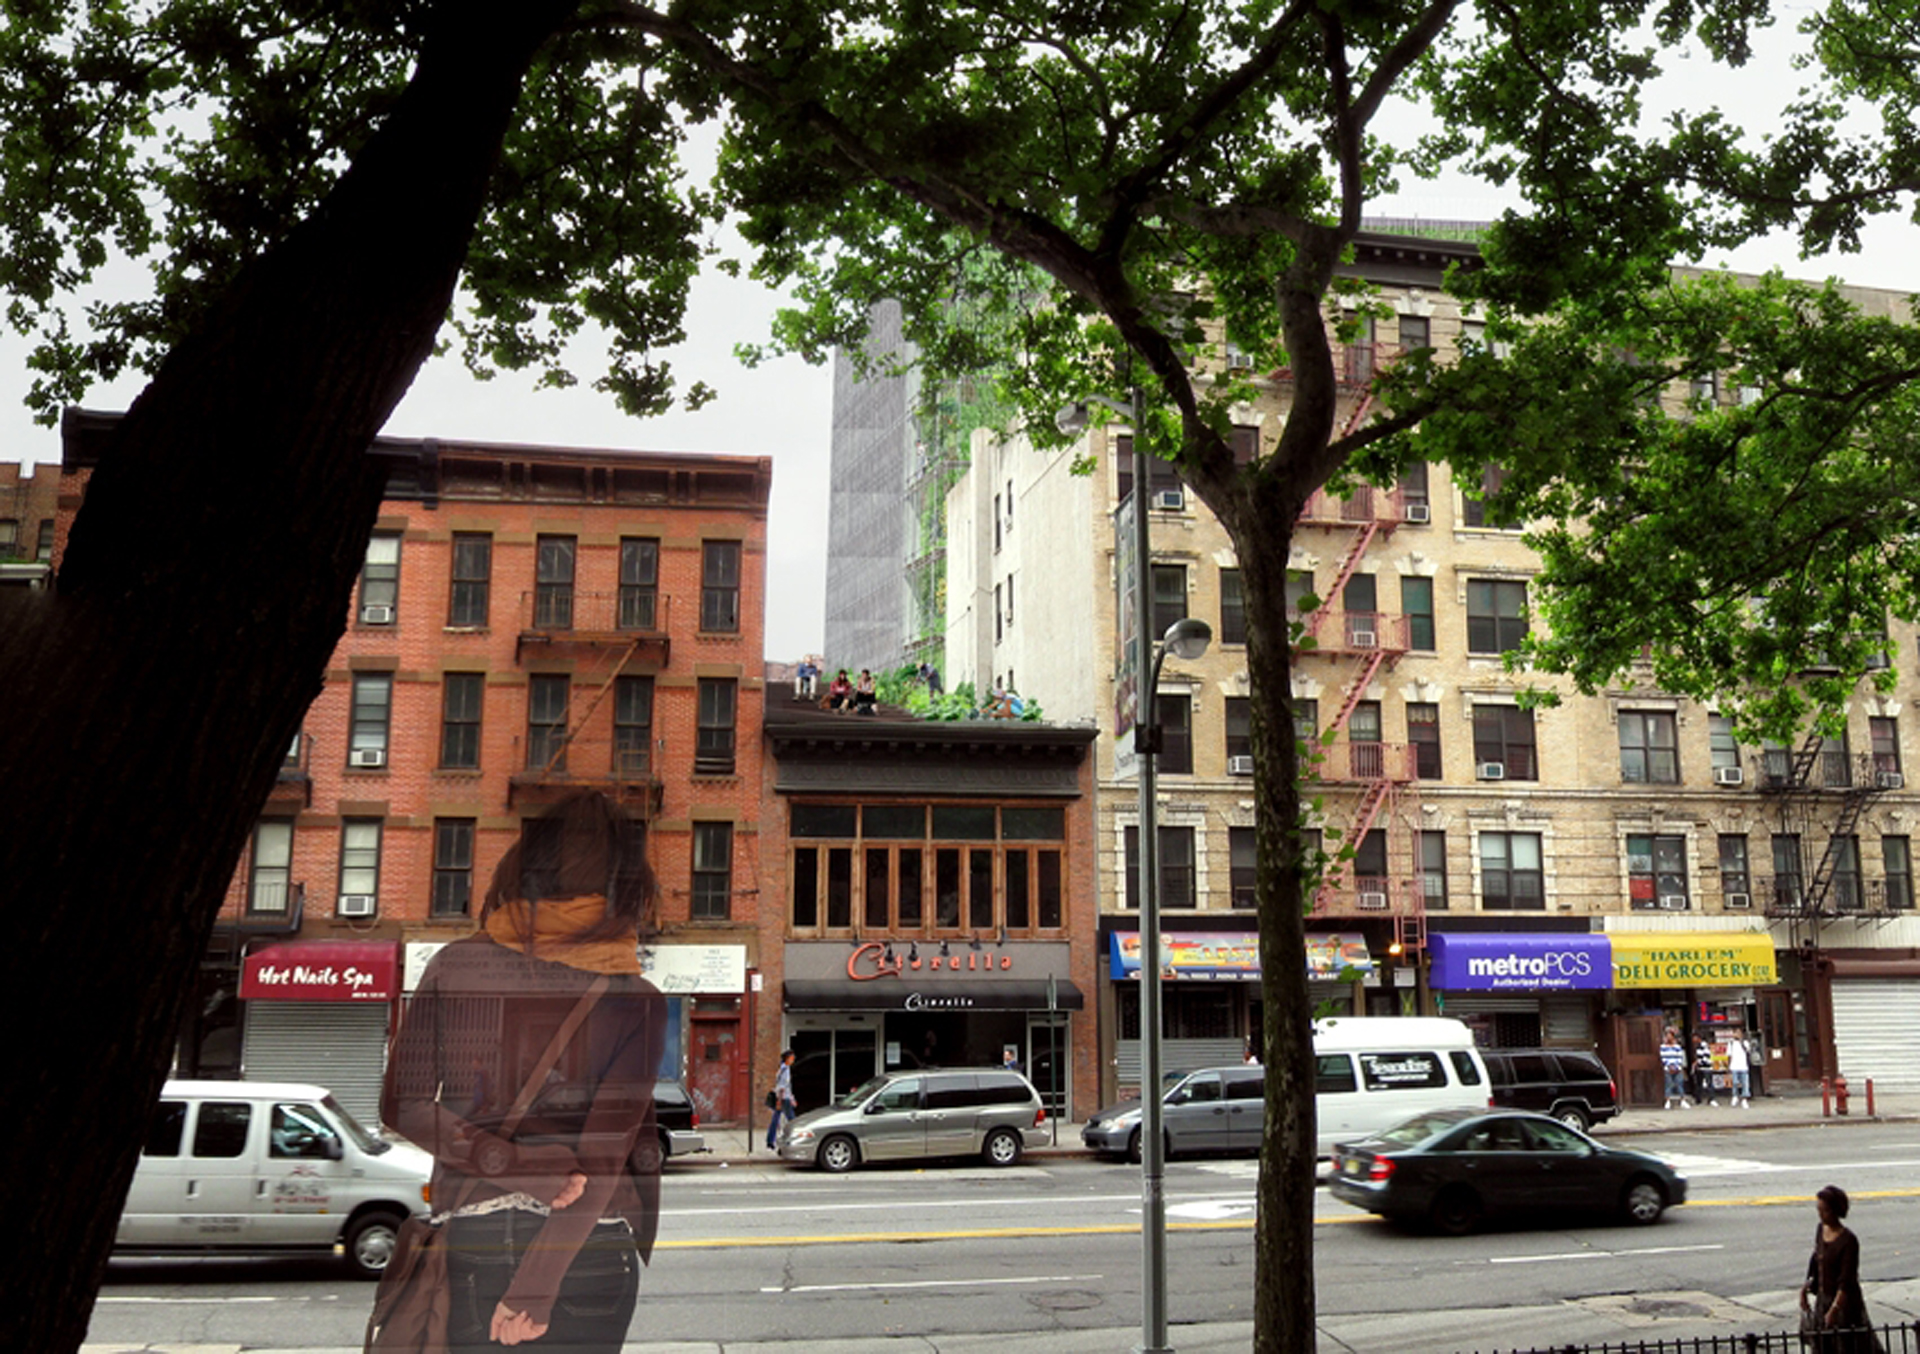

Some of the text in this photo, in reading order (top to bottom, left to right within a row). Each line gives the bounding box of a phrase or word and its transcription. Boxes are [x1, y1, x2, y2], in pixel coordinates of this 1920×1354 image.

[1468, 952, 1592, 976] metroPCS
[1619, 965, 1660, 979] DELI
[1665, 962, 1752, 979] GROCERY
[258, 966, 374, 990] Hot Nails Spa
